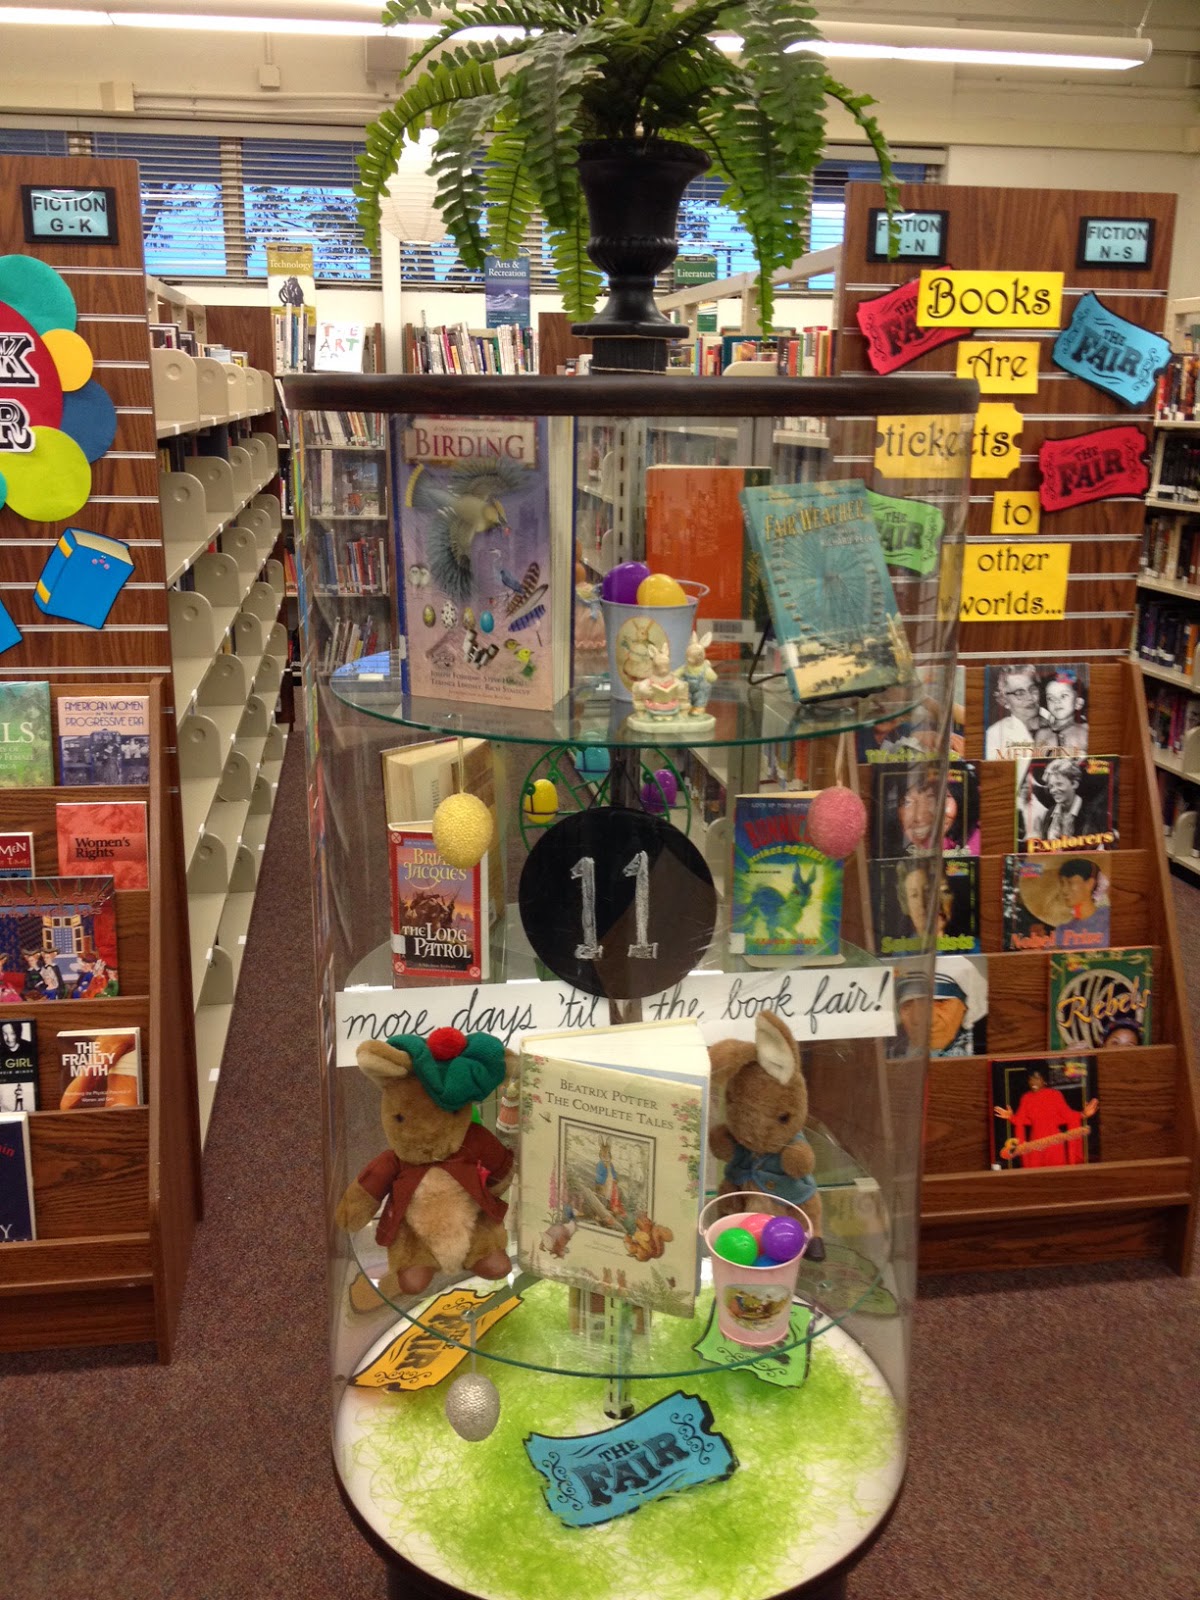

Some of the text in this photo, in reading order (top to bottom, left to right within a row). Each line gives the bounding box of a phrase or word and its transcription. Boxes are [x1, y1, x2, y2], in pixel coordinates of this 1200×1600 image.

[33, 196, 106, 212] FICTION
[878, 219, 941, 233] FTION
[1088, 226, 1147, 241] FICTION
[269, 259, 313, 271] Technology
[488, 267, 528, 277] Recreation
[494, 260, 511, 269] Arts
[677, 268, 716, 278] Literature
[926, 277, 1051, 319] Books
[1102, 328, 1127, 346] THE
[1071, 325, 1143, 378] FAIR
[966, 347, 1029, 381] Are
[413, 427, 525, 460] BIRDING
[884, 421, 1011, 461] tickets
[1057, 448, 1126, 497] FAIR
[765, 498, 865, 544] FAIR WEATHER
[1002, 499, 1033, 526] to
[977, 546, 1050, 574] other
[64, 700, 144, 712] AMERICAN WOMEN
[64, 716, 145, 727] PROGRESSIVE ERA
[74, 836, 131, 848] Women's
[1026, 831, 1115, 855] Explorers
[74, 848, 115, 860] Rights
[403, 861, 467, 883] JACQUES
[569, 850, 660, 960] 11
[402, 921, 468, 944] THE LONG
[413, 936, 472, 960] PATROL
[342, 1008, 436, 1040] more
[450, 987, 538, 1047] days
[648, 980, 704, 1021] the
[720, 974, 795, 1021] book
[803, 970, 891, 1035] fair!
[1057, 975, 1152, 1028] Rebels
[74, 1041, 102, 1054] THE
[5, 1057, 34, 1069] GIRL
[61, 1052, 116, 1067] FRAILTY
[70, 1065, 109, 1078] MYTH
[559, 1078, 659, 1111] BEATRIX POTTER
[545, 1092, 675, 1131] THE COMPLETE TALES
[598, 1439, 637, 1463] THE
[571, 1431, 691, 1507] FAIR
